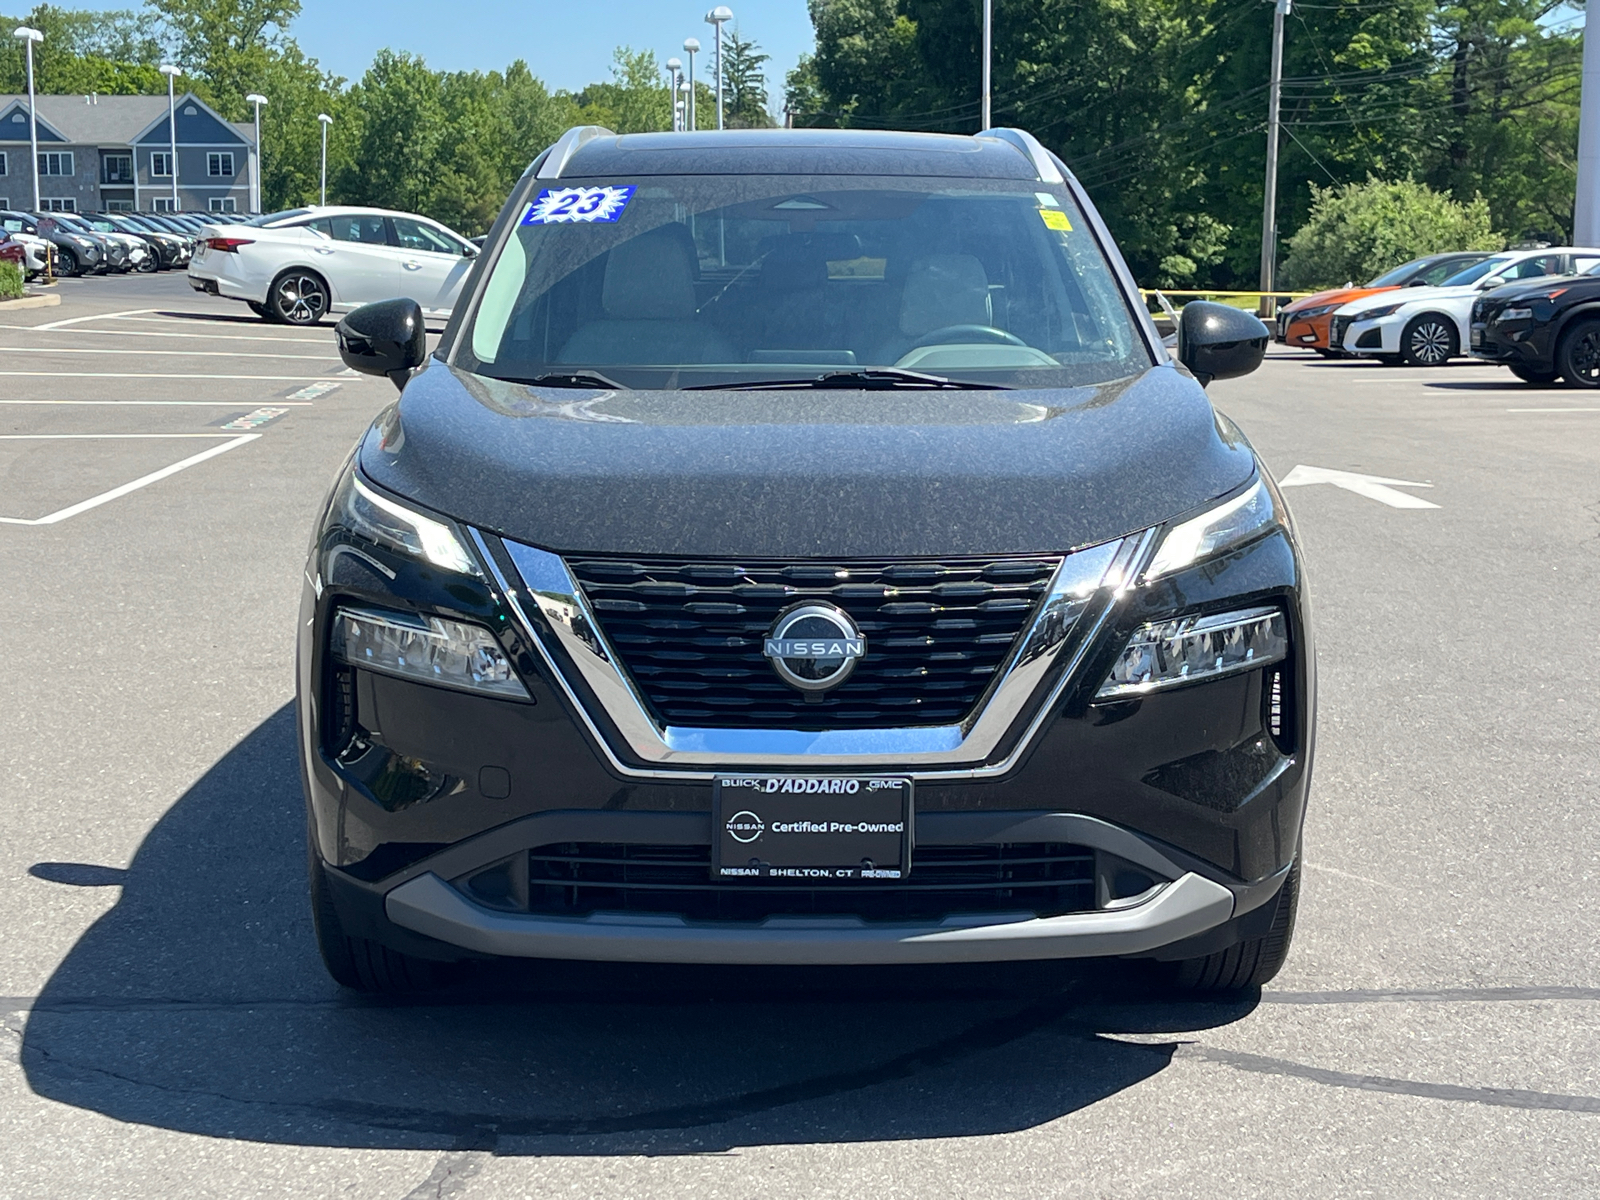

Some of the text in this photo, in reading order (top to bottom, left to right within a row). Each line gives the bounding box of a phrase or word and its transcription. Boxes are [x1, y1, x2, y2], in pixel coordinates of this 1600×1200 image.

[547, 192, 606, 215] 23
[767, 642, 861, 655] NISSAN
[721, 778, 903, 794] BUICK D'ADDARIO GMC
[771, 821, 904, 833] Certified Pre-Owned
[720, 868, 759, 876] NISSAN
[769, 869, 833, 878] SHELTON,
